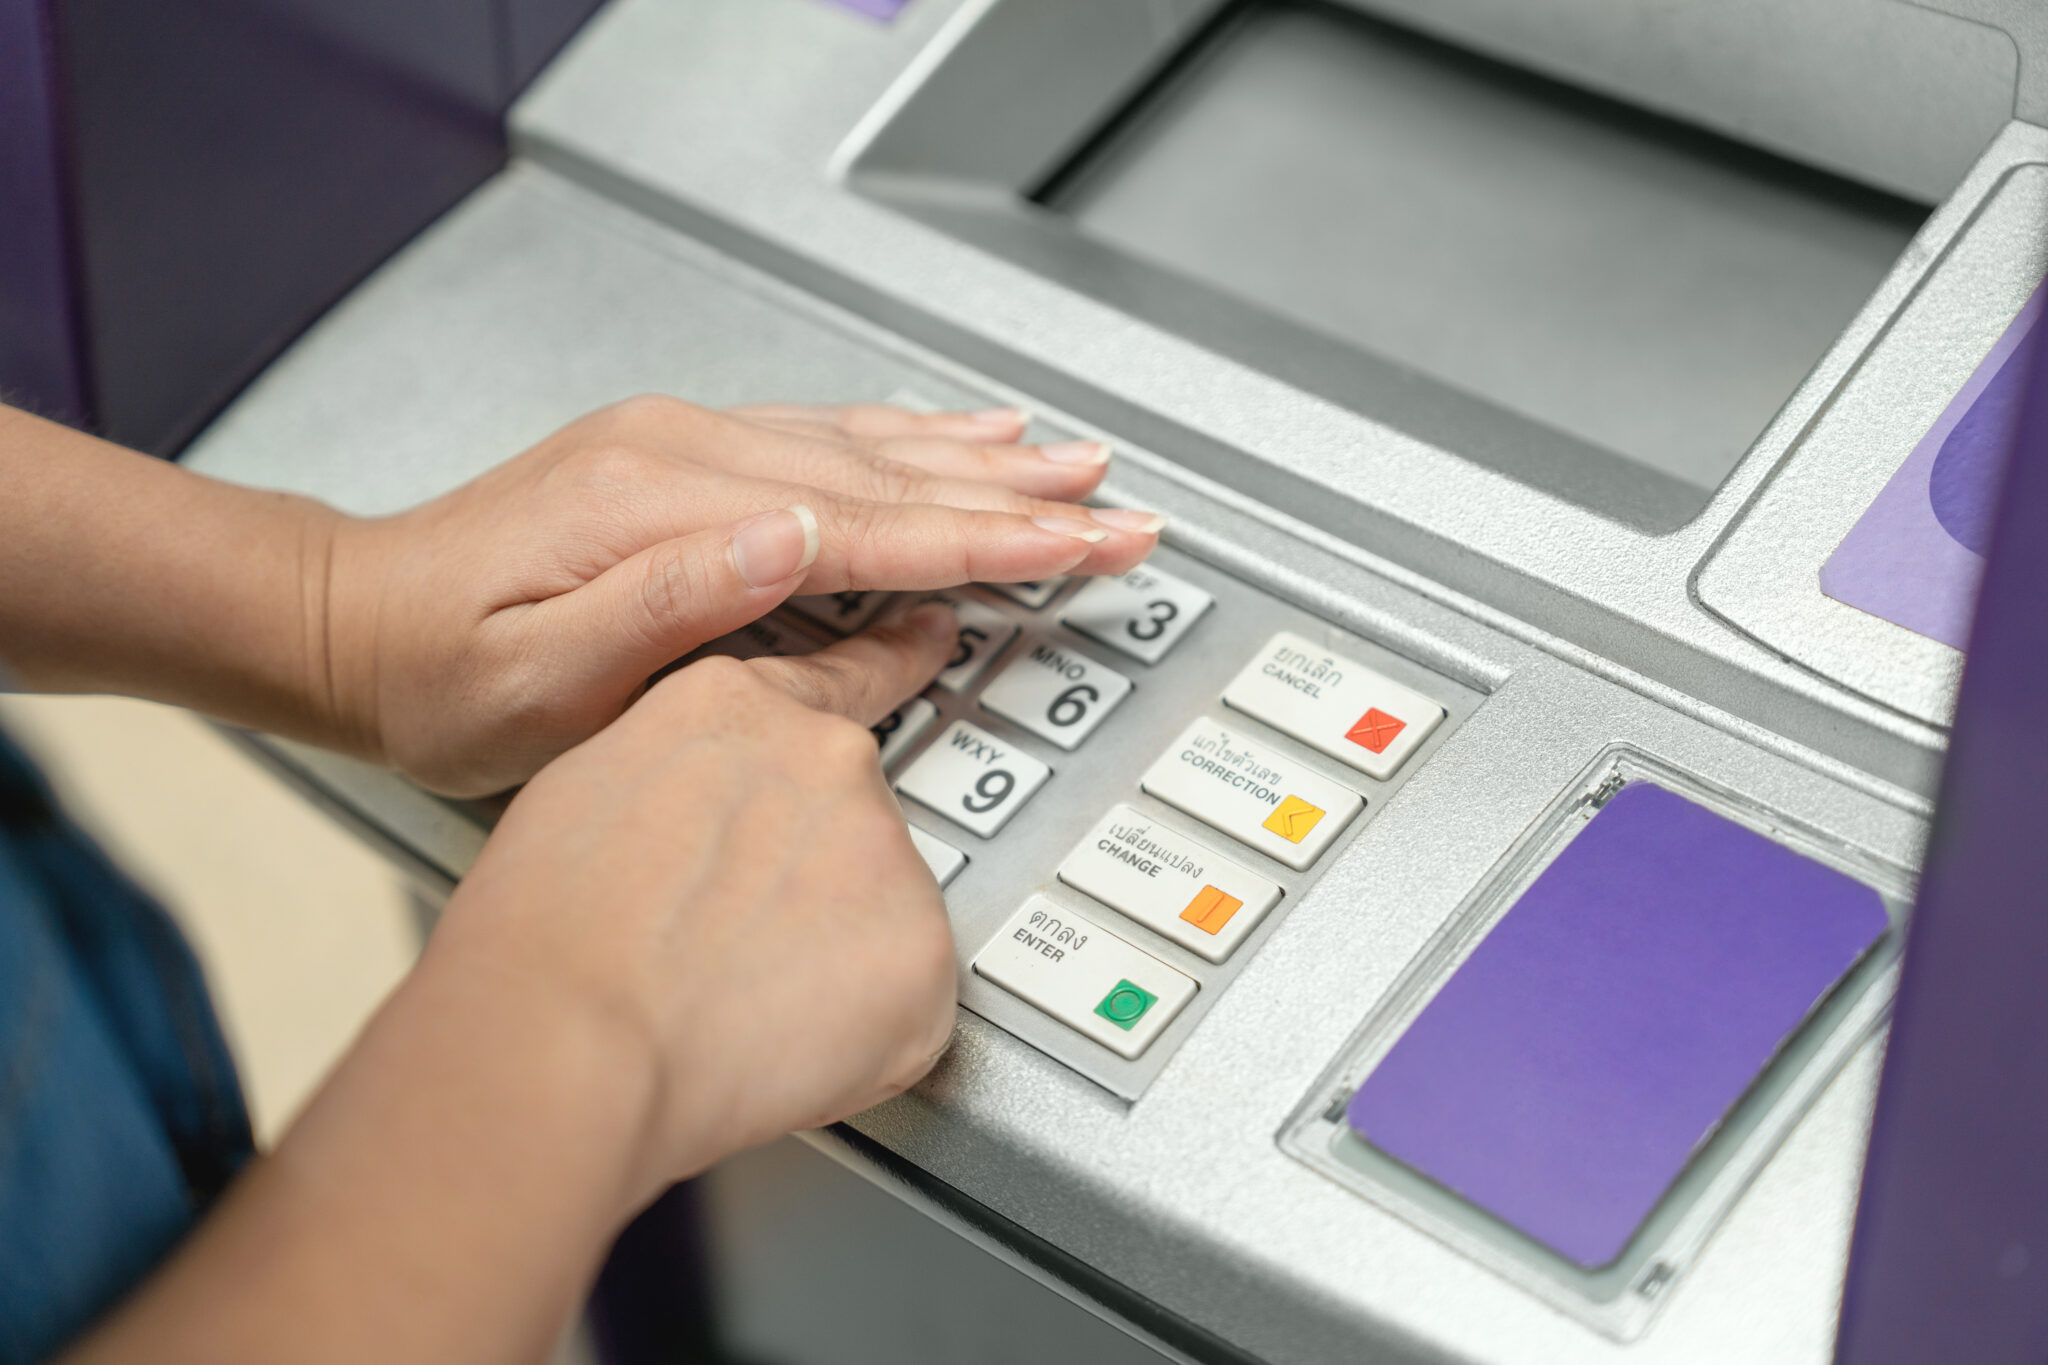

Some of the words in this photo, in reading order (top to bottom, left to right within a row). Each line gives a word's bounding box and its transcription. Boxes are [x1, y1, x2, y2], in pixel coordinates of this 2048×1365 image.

[1127, 600, 1178, 641] 3
[1030, 646, 1086, 681] MNO
[1262, 663, 1321, 700] CANCEL
[1273, 646, 1344, 688] ยกเลิก
[1047, 683, 1099, 726] 6
[952, 730, 1005, 765] WXY
[962, 769, 1016, 814] 9
[1181, 749, 1281, 806] CORRECTION
[1097, 839, 1163, 878] CHANGE
[1108, 823, 1204, 879] เปลี่ยนแปลง
[1013, 928, 1065, 963] ENTER
[1029, 911, 1088, 951] ตกลง
